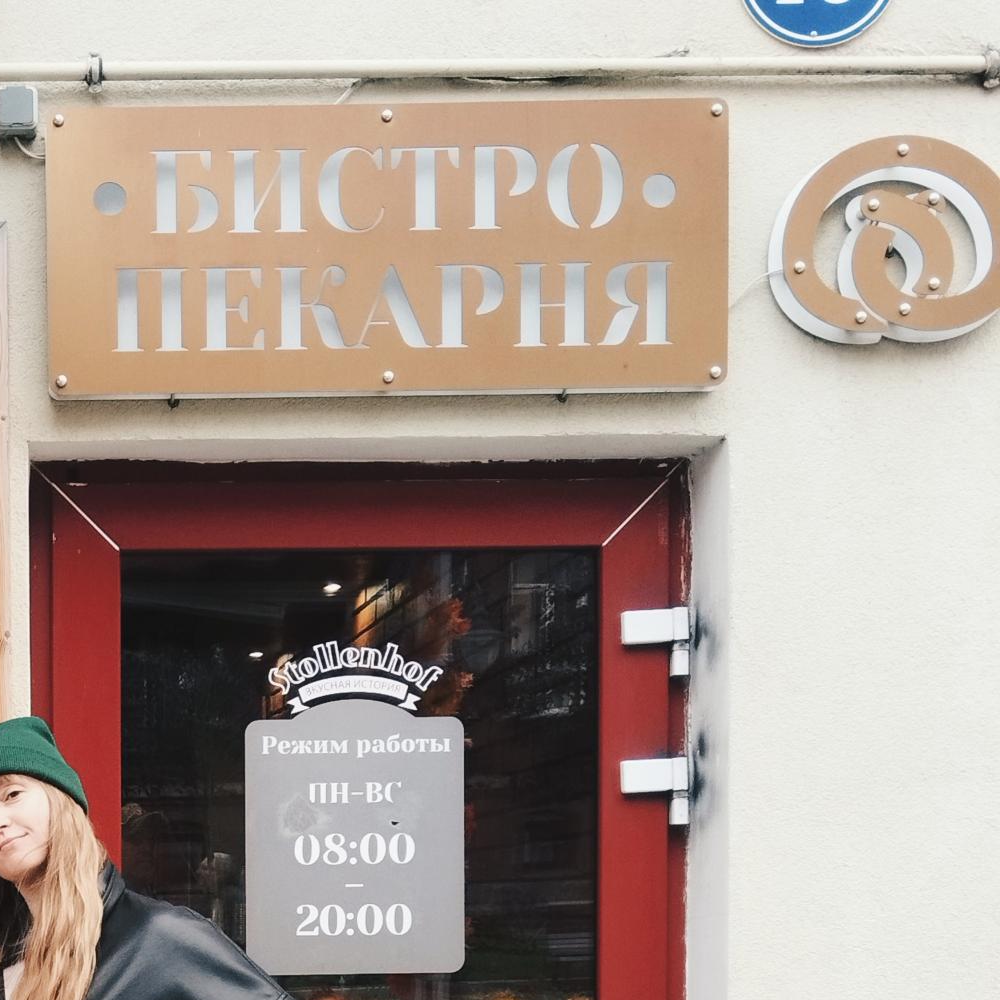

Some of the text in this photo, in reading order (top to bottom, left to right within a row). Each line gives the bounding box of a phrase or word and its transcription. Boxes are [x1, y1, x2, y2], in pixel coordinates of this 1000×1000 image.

[150, 143, 623, 234] БИСТРО
[112, 261, 673, 352] ПЕКАРНЯ
[268, 641, 444, 695] Stollenhof
[353, 679, 401, 693] ИСТОРИЯ
[261, 733, 452, 758] Режим работы
[294, 832, 416, 865] 08:00
[295, 903, 413, 936] 20:00
